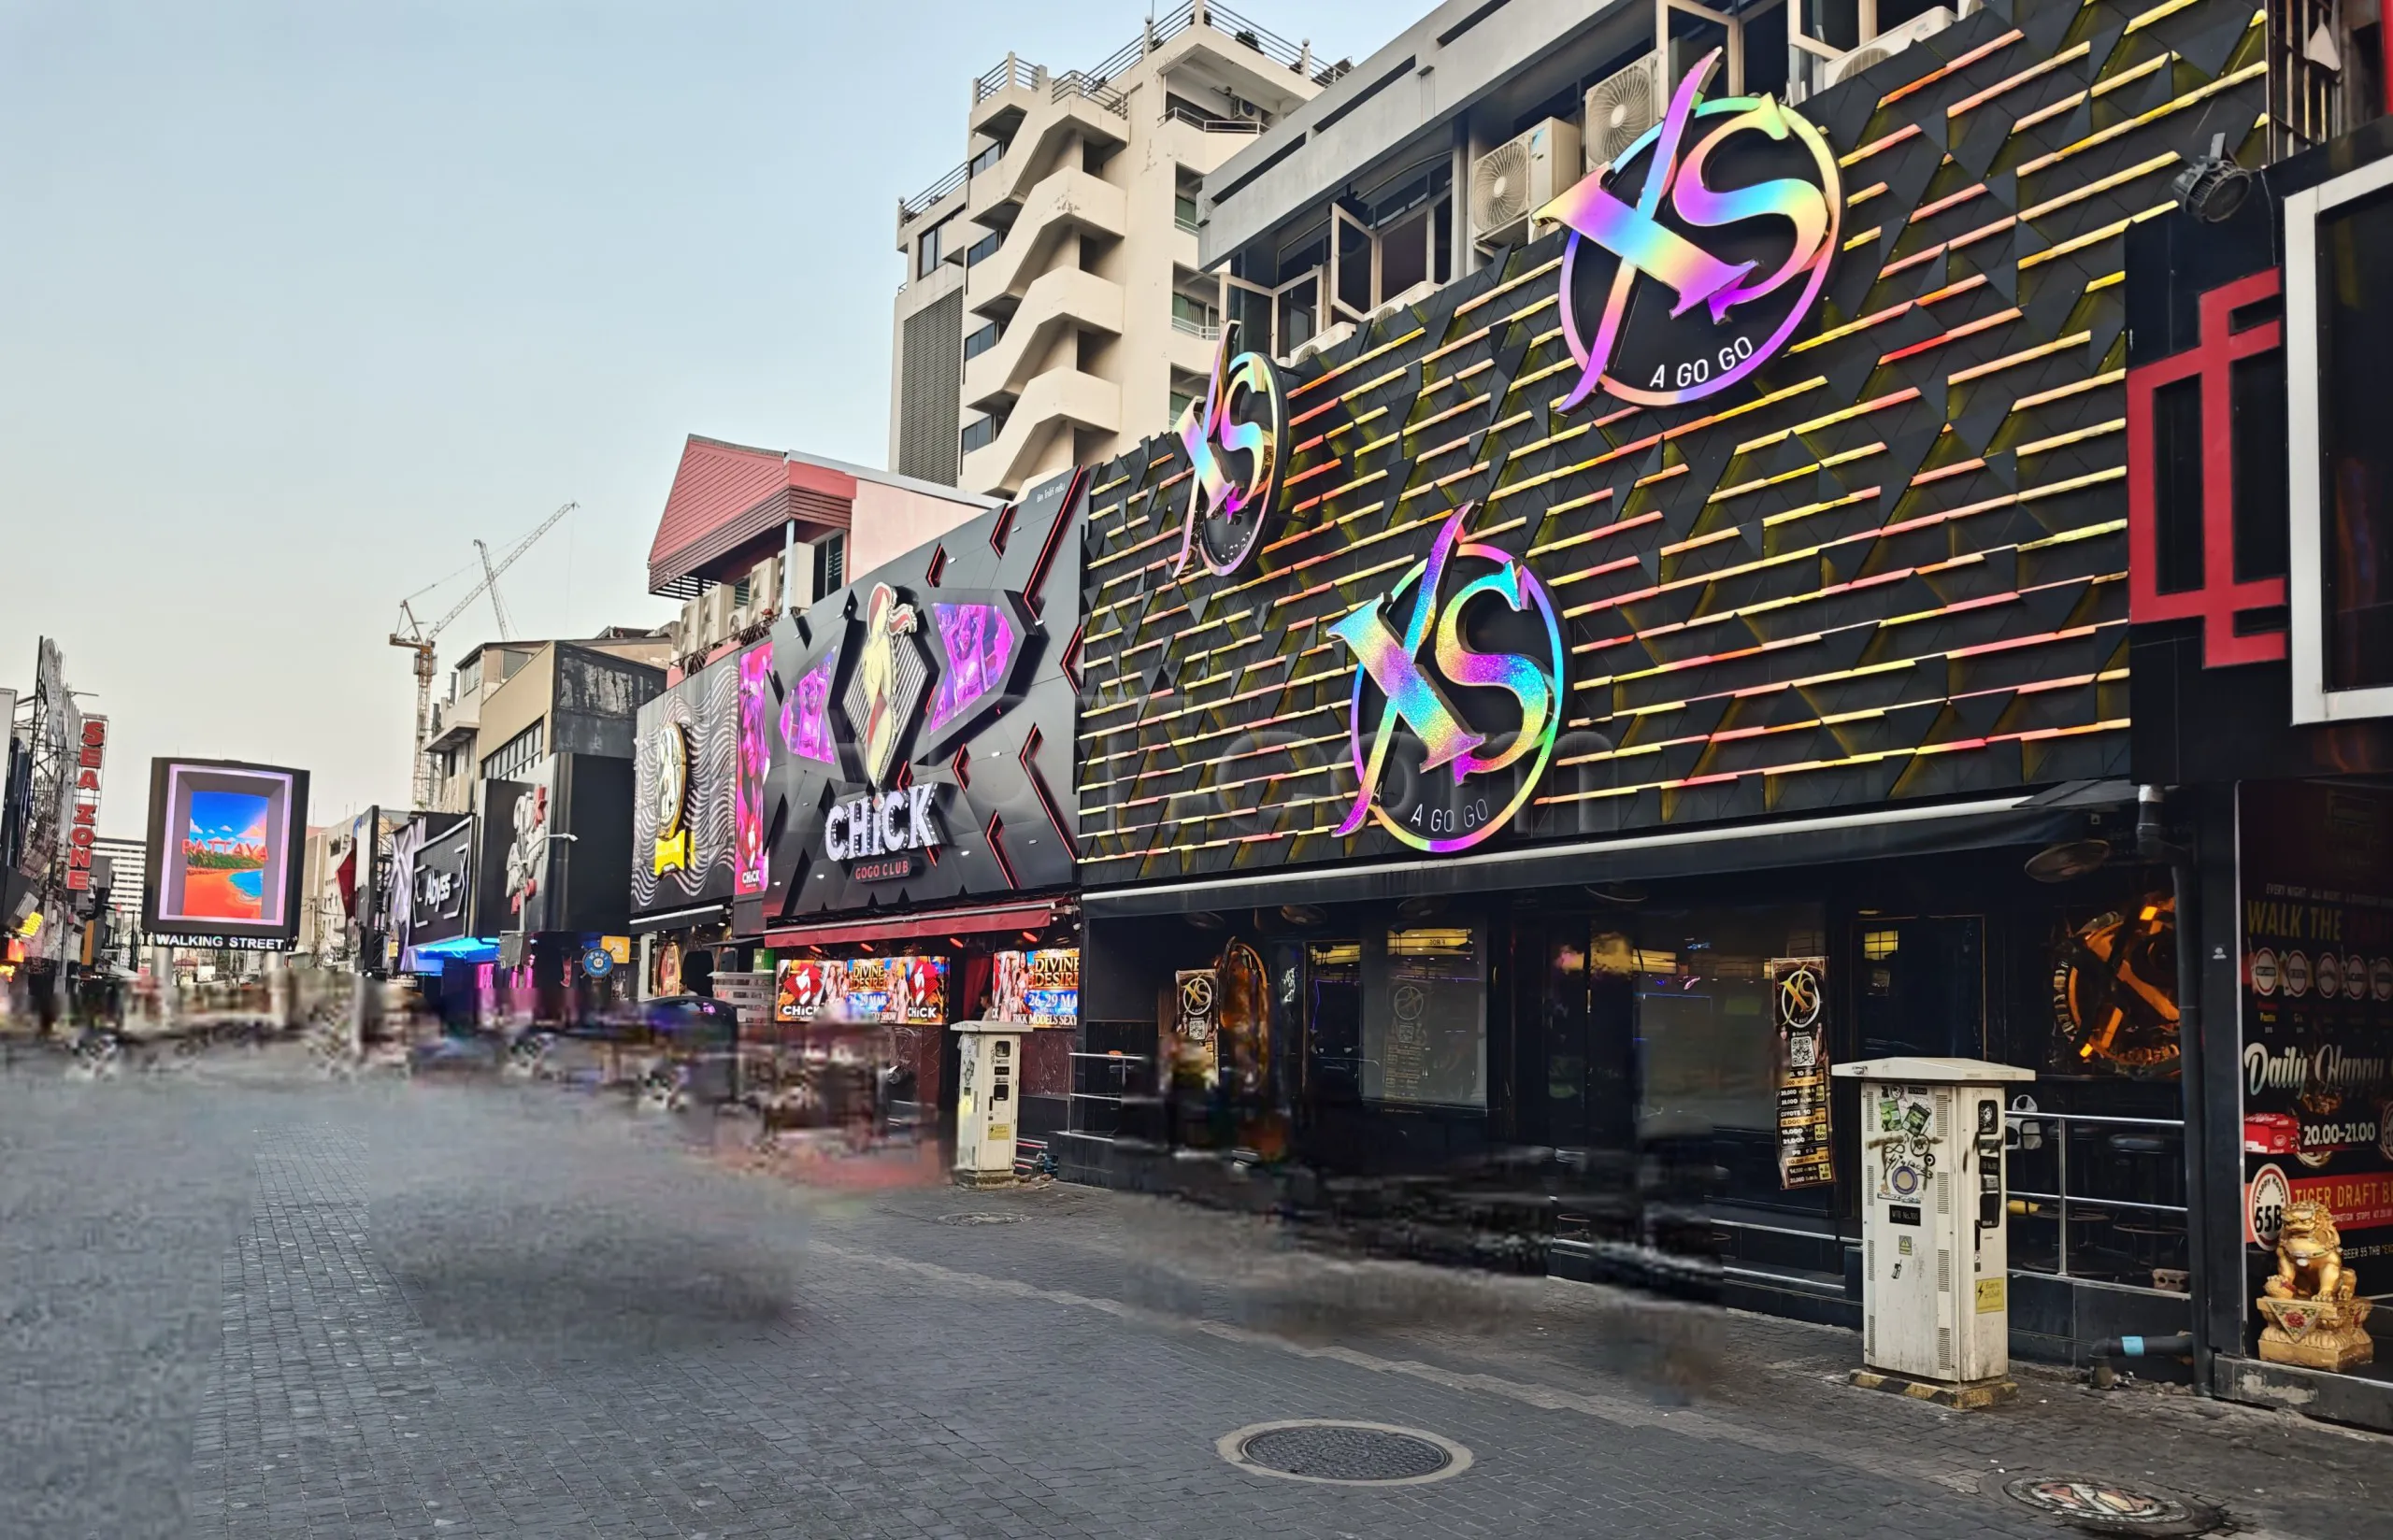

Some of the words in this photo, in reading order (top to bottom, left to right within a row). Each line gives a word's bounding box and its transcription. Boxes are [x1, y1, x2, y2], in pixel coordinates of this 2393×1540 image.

[1530, 46, 1830, 413] XS
[1649, 364, 1665, 388] A
[1676, 359, 1710, 387] GO
[1718, 336, 1753, 372] GO
[1172, 321, 1265, 578] XS
[1325, 499, 1549, 837] XS
[76, 721, 106, 791] SEA
[1411, 804, 1423, 827] A
[1430, 809, 1455, 833] GO
[1464, 799, 1489, 828] GO
[66, 805, 97, 892] ZONE
[181, 837, 270, 862] PATTAYA
[854, 864, 881, 881] GOGO
[883, 859, 910, 877] CLUB
[424, 869, 451, 912] Abyss
[2266, 883, 2286, 895] EVERY
[2286, 886, 2306, 898] NIGHT
[2246, 900, 2303, 938] WALK
[2310, 906, 2343, 941] THE
[156, 934, 223, 948] WALKING
[229, 937, 284, 949] STREET
[853, 965, 885, 977] DIVINE
[1028, 993, 1058, 1007] 26-29
[1779, 963, 1817, 1025] XS
[881, 1011, 897, 1021] SHOW
[1012, 1014, 1027, 1024] BKK
[1028, 1013, 1058, 1025] MODELS
[2244, 1042, 2308, 1100] Daily
[2314, 1044, 2385, 1098] Happy
[2303, 1122, 2376, 1146] 20.00-21.00
[2256, 1177, 2271, 1204] Happy
[2338, 1183, 2377, 1207] DRAFT
[2343, 1248, 2358, 1260] BEER
